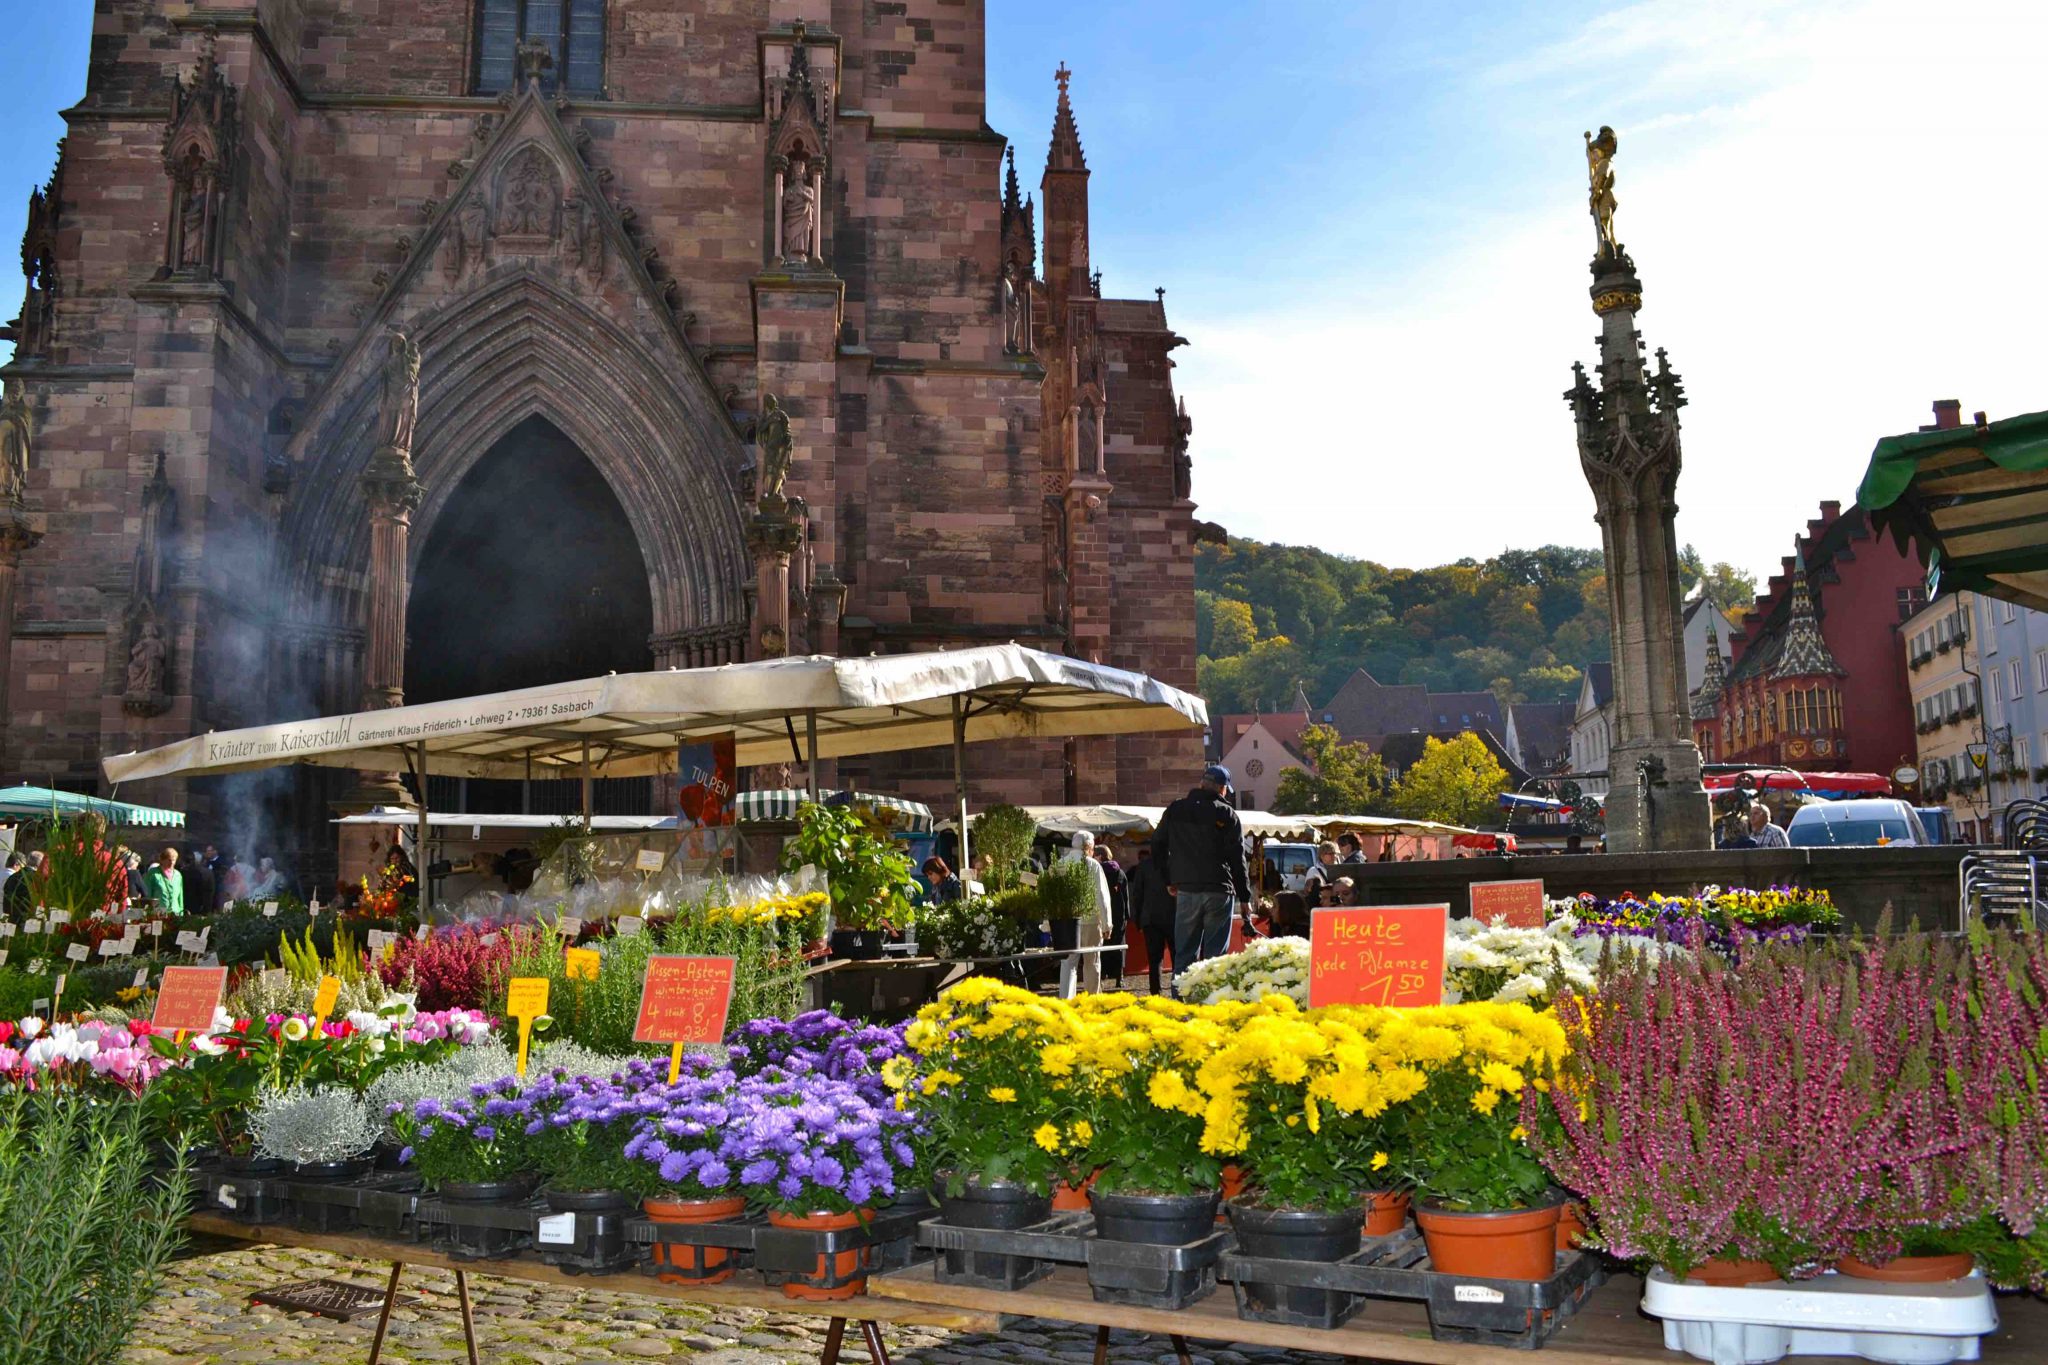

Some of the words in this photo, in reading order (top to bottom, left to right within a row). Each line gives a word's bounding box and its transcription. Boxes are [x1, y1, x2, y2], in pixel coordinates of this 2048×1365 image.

[358, 726, 396, 742] Gärtnerei
[397, 724, 421, 737] Klaus
[423, 717, 462, 733] Friderich
[469, 712, 505, 728] Lehweg
[506, 710, 513, 721] 2
[521, 705, 549, 719] 79361
[551, 699, 594, 715] Sasbach
[209, 741, 256, 761] Kräuter
[257, 742, 277, 754] vom
[280, 716, 353, 752] Kaiserstuhl
[692, 765, 730, 797] TULPEN
[1333, 914, 1402, 940] Heute
[648, 960, 728, 979] Kissen-Astern
[1315, 953, 1347, 978] jede
[1357, 948, 1430, 976] Pflanze
[655, 983, 717, 997] winterhart
[163, 997, 169, 1010] 3
[647, 1001, 660, 1019] 4
[160, 1014, 167, 1024] 1
[643, 1024, 654, 1040] 1
